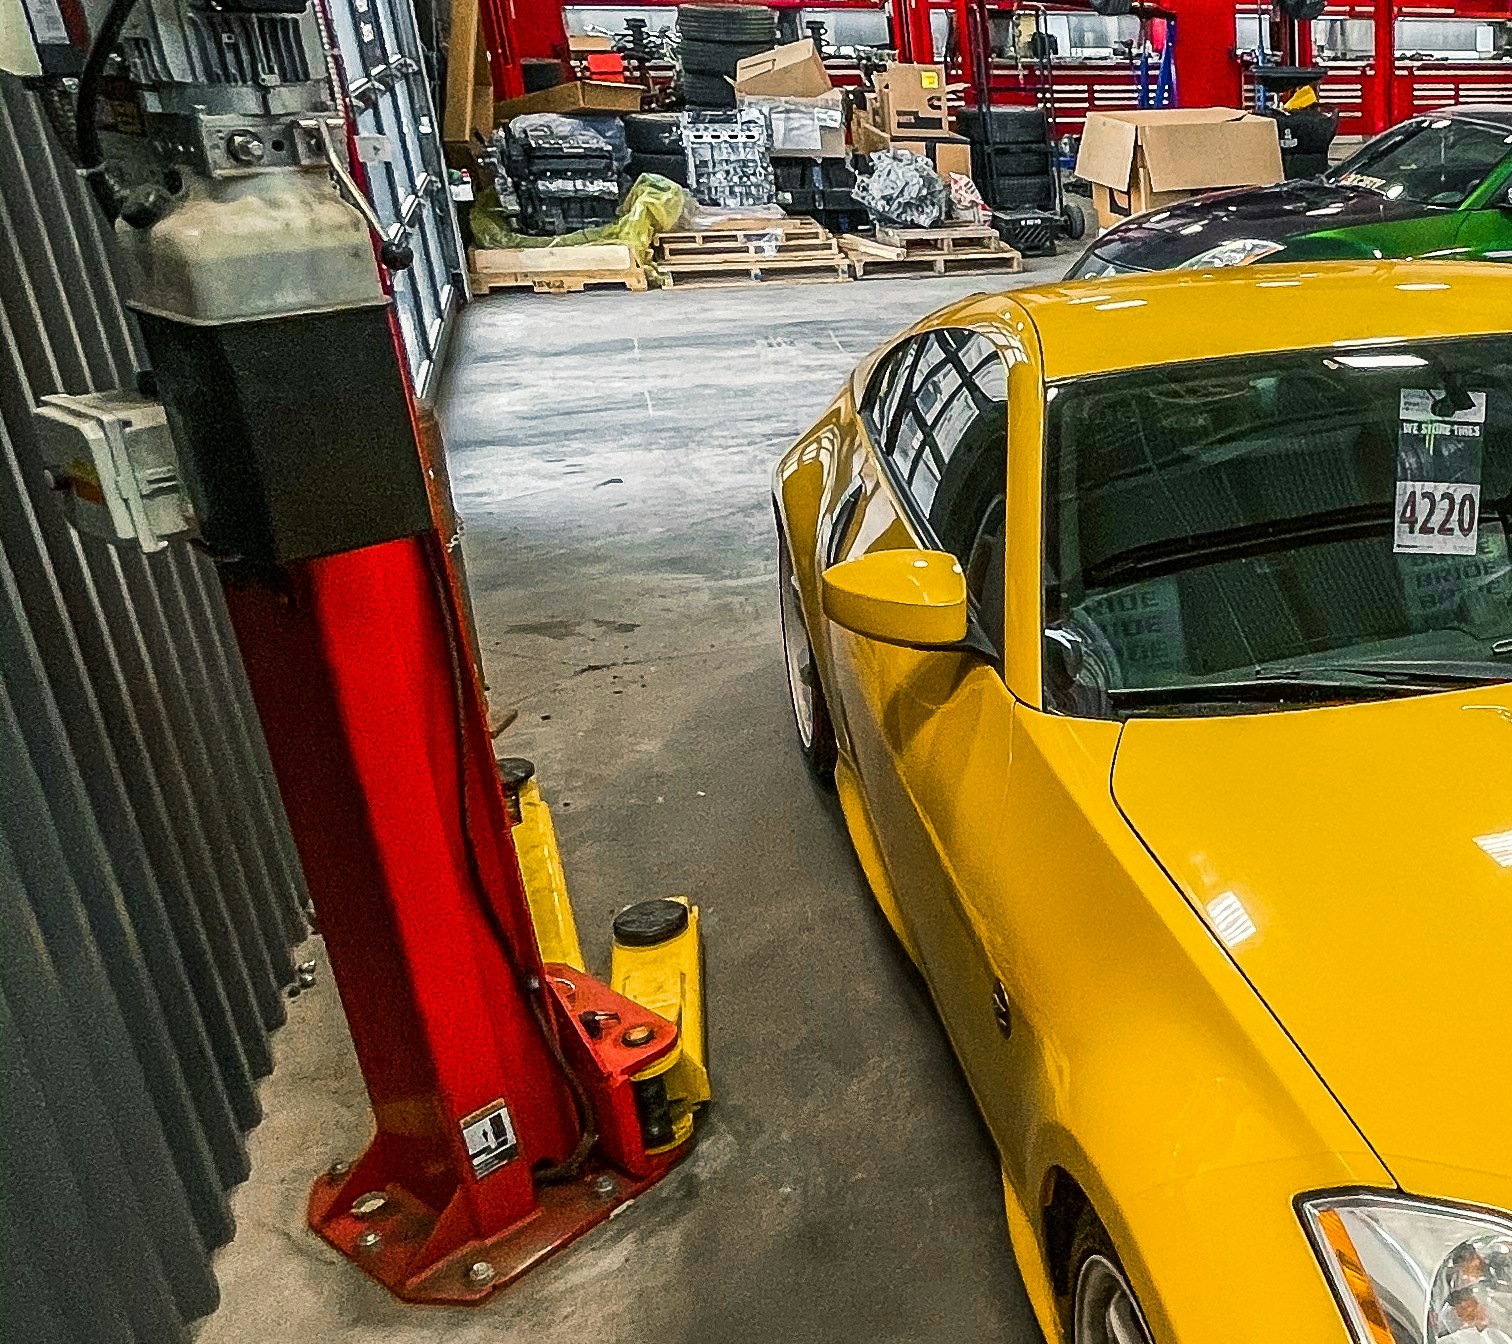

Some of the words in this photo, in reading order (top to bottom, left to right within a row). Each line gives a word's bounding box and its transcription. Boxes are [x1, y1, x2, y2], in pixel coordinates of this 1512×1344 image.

[1403, 422, 1419, 434] WE
[1452, 424, 1480, 437] TIRES
[1400, 490, 1476, 537] 4220
